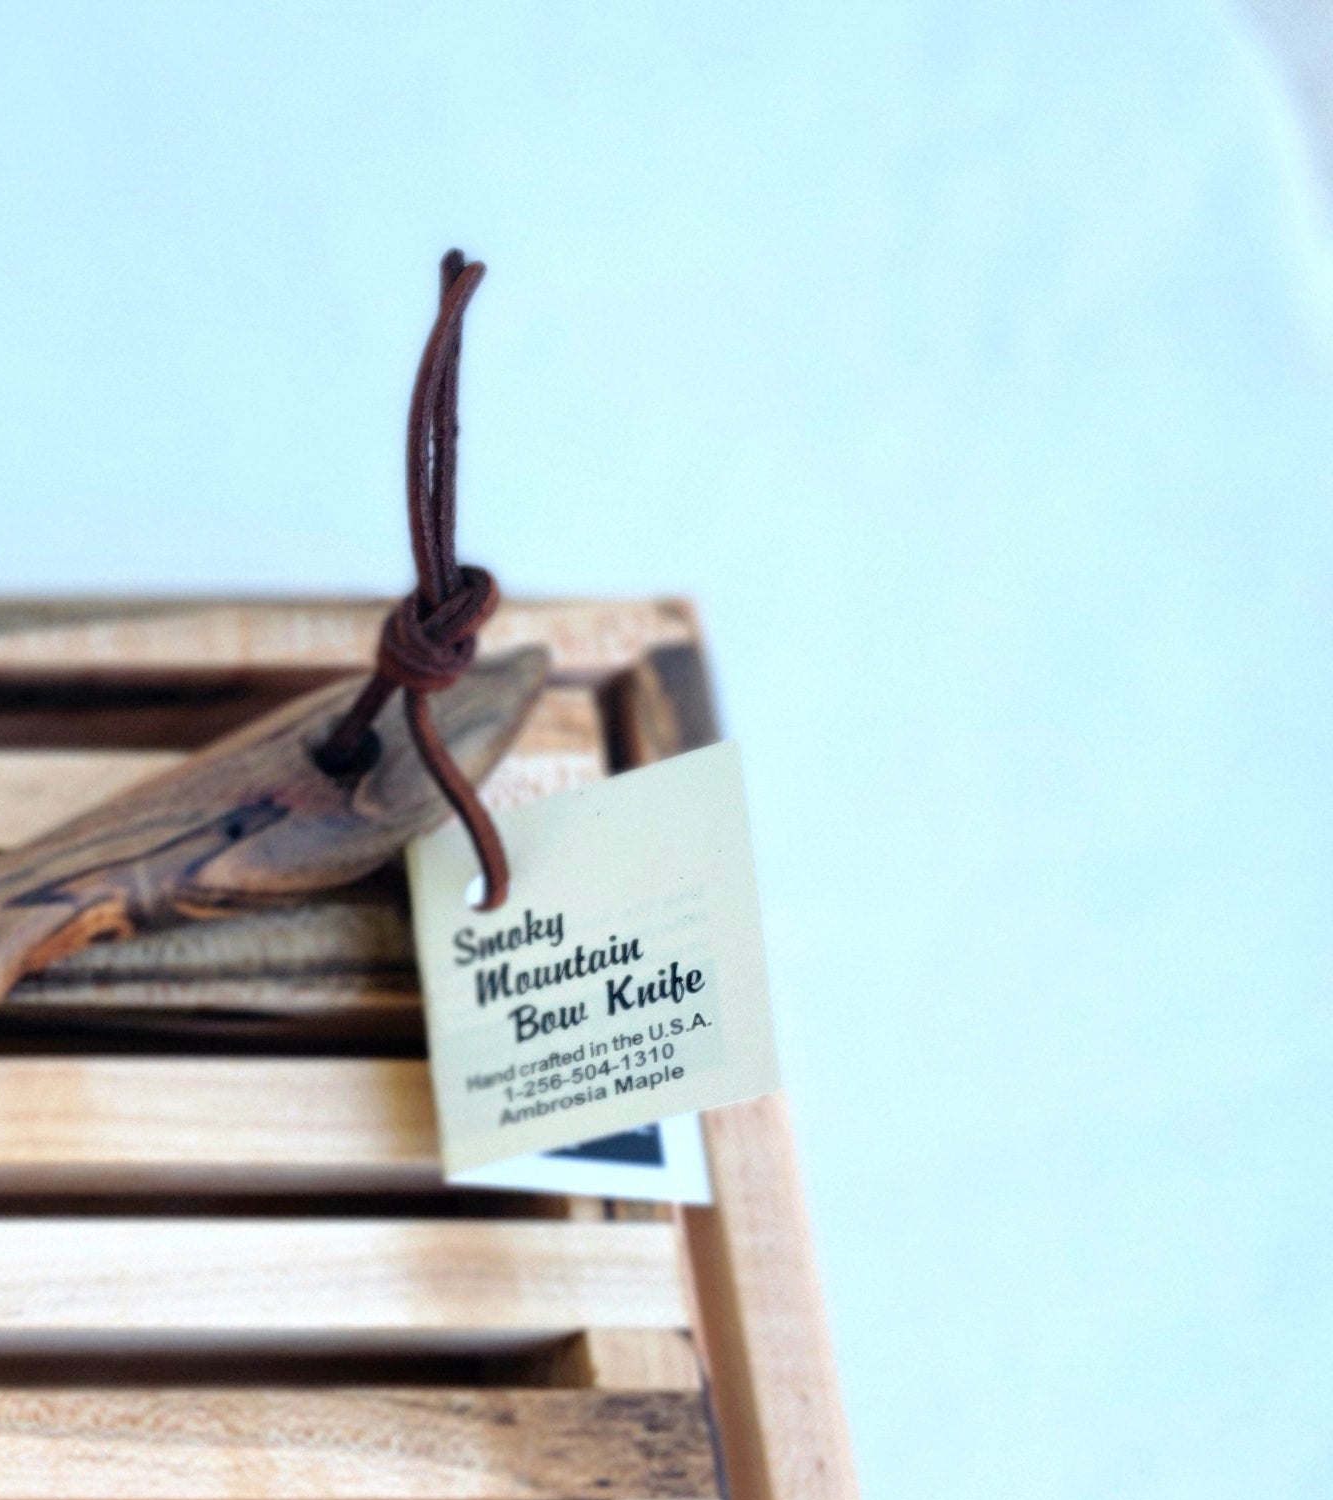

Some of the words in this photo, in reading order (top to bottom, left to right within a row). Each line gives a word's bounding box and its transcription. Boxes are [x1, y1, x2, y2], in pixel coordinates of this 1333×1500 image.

[453, 909, 564, 967] Smoky
[475, 935, 644, 1005] Mountain
[508, 1002, 588, 1043] Bow
[606, 962, 705, 1016] Knife
[466, 1064, 515, 1091] Hand
[519, 1045, 585, 1078] crafted
[590, 1040, 608, 1056] in
[612, 1031, 643, 1051] the
[648, 1012, 712, 1041] U.S.A.
[504, 1042, 675, 1102] 1-256-504-1310
[499, 1086, 607, 1126] Ambrosia
[614, 1065, 684, 1096] Maple
